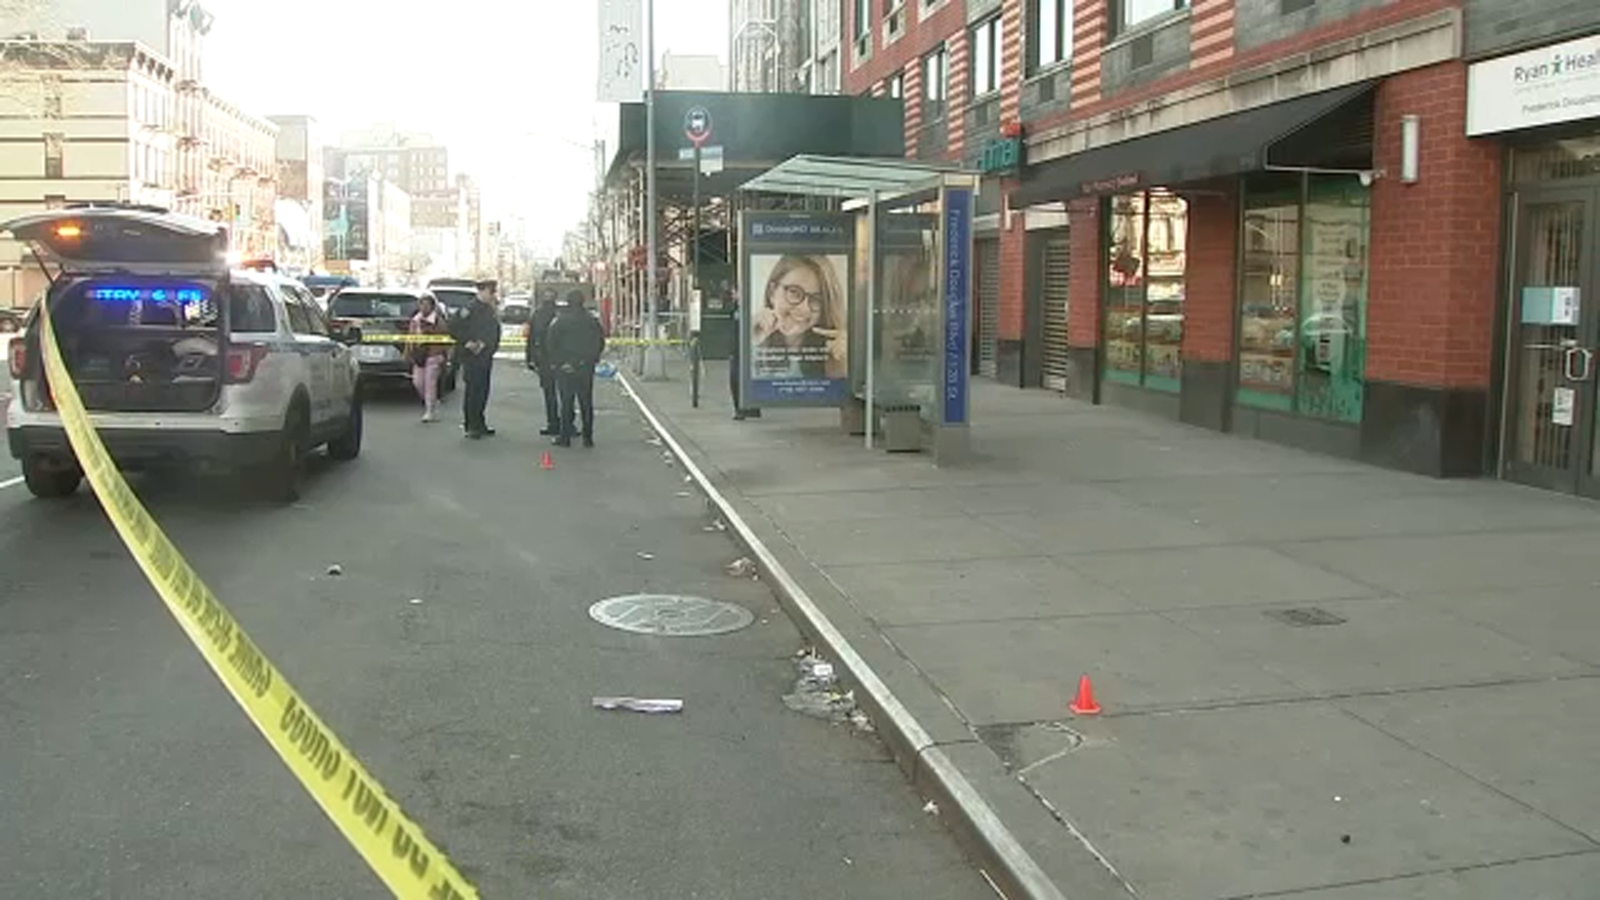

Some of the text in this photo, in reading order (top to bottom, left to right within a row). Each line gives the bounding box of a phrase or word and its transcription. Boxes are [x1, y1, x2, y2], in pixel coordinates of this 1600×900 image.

[1515, 65, 1548, 82] Ryan
[279, 695, 342, 782] CROSS
[340, 765, 390, 838] NOT
